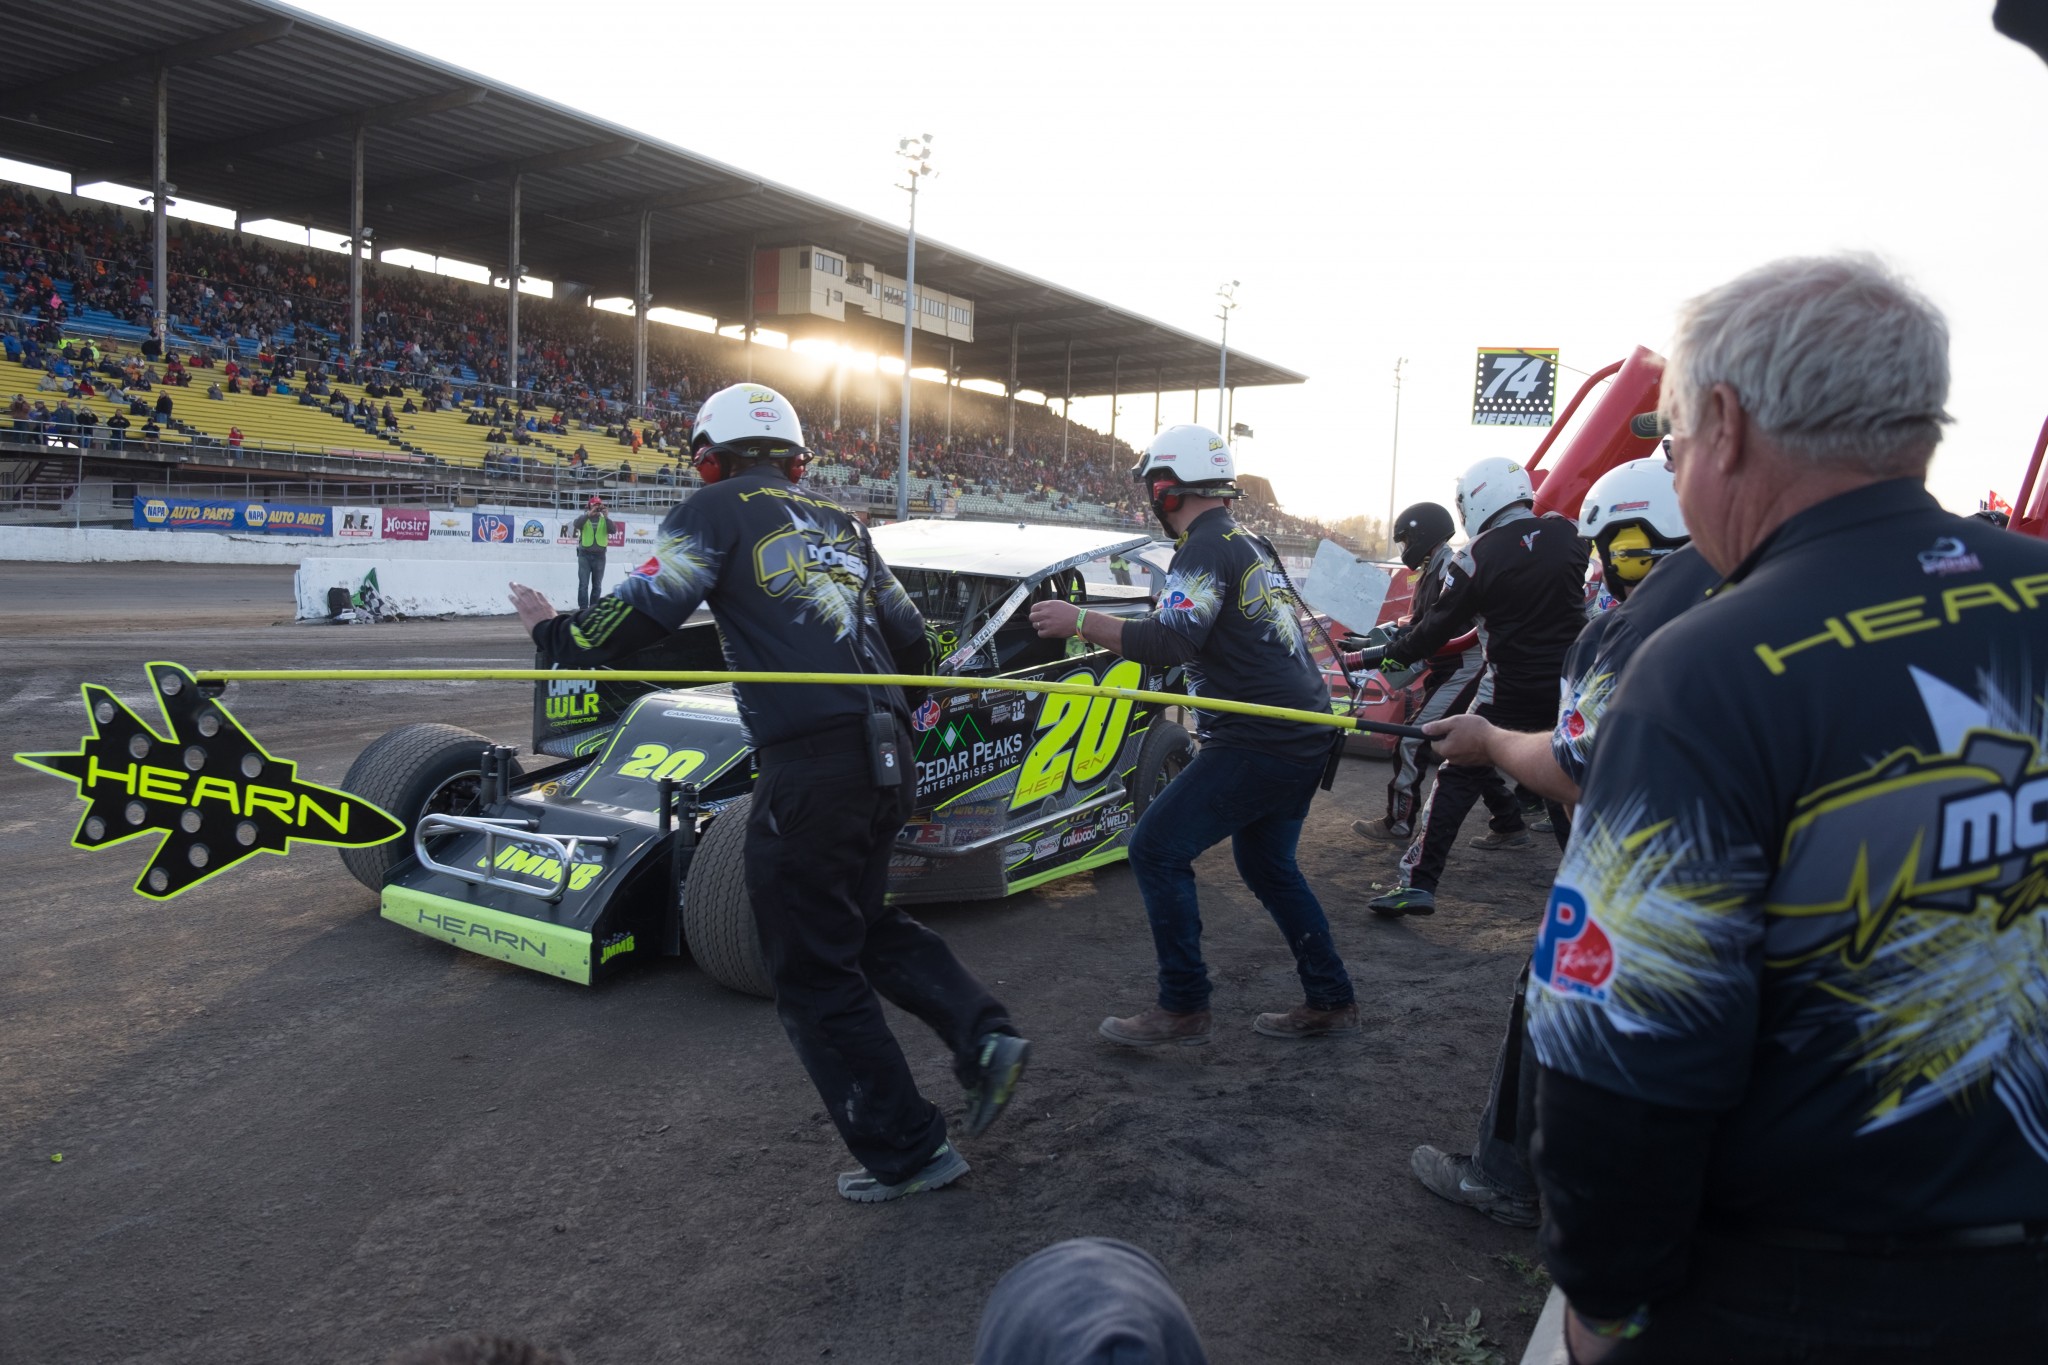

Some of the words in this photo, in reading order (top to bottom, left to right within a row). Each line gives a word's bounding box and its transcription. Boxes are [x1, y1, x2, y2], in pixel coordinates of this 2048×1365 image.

[1481, 357, 1546, 400] 74
[749, 391, 774, 404] 20
[754, 411, 777, 419] BELL
[1473, 412, 1553, 427] HEFFNER
[147, 506, 165, 517] NAPA
[170, 506, 201, 520] AUTO
[202, 507, 236, 521] PARTS
[248, 510, 264, 521] NAPA
[268, 511, 295, 524] AUTO
[296, 512, 326, 526] PARTS
[384, 516, 428, 532] Hoosier
[430, 529, 471, 538] PERFORMANCE
[546, 693, 600, 719] WLR
[1008, 659, 1142, 812] 20
[617, 743, 706, 782] 20
[884, 753, 895, 768] 3
[915, 750, 969, 785] CEDAR
[973, 733, 1023, 766] PEAKS
[916, 762, 994, 797] ENTERPRISES
[1000, 756, 1019, 768] INC.
[87, 755, 350, 835] HEARN
[1107, 812, 1129, 828] WELD
[417, 908, 547, 958] HEARN
[600, 935, 636, 965] JMMB
